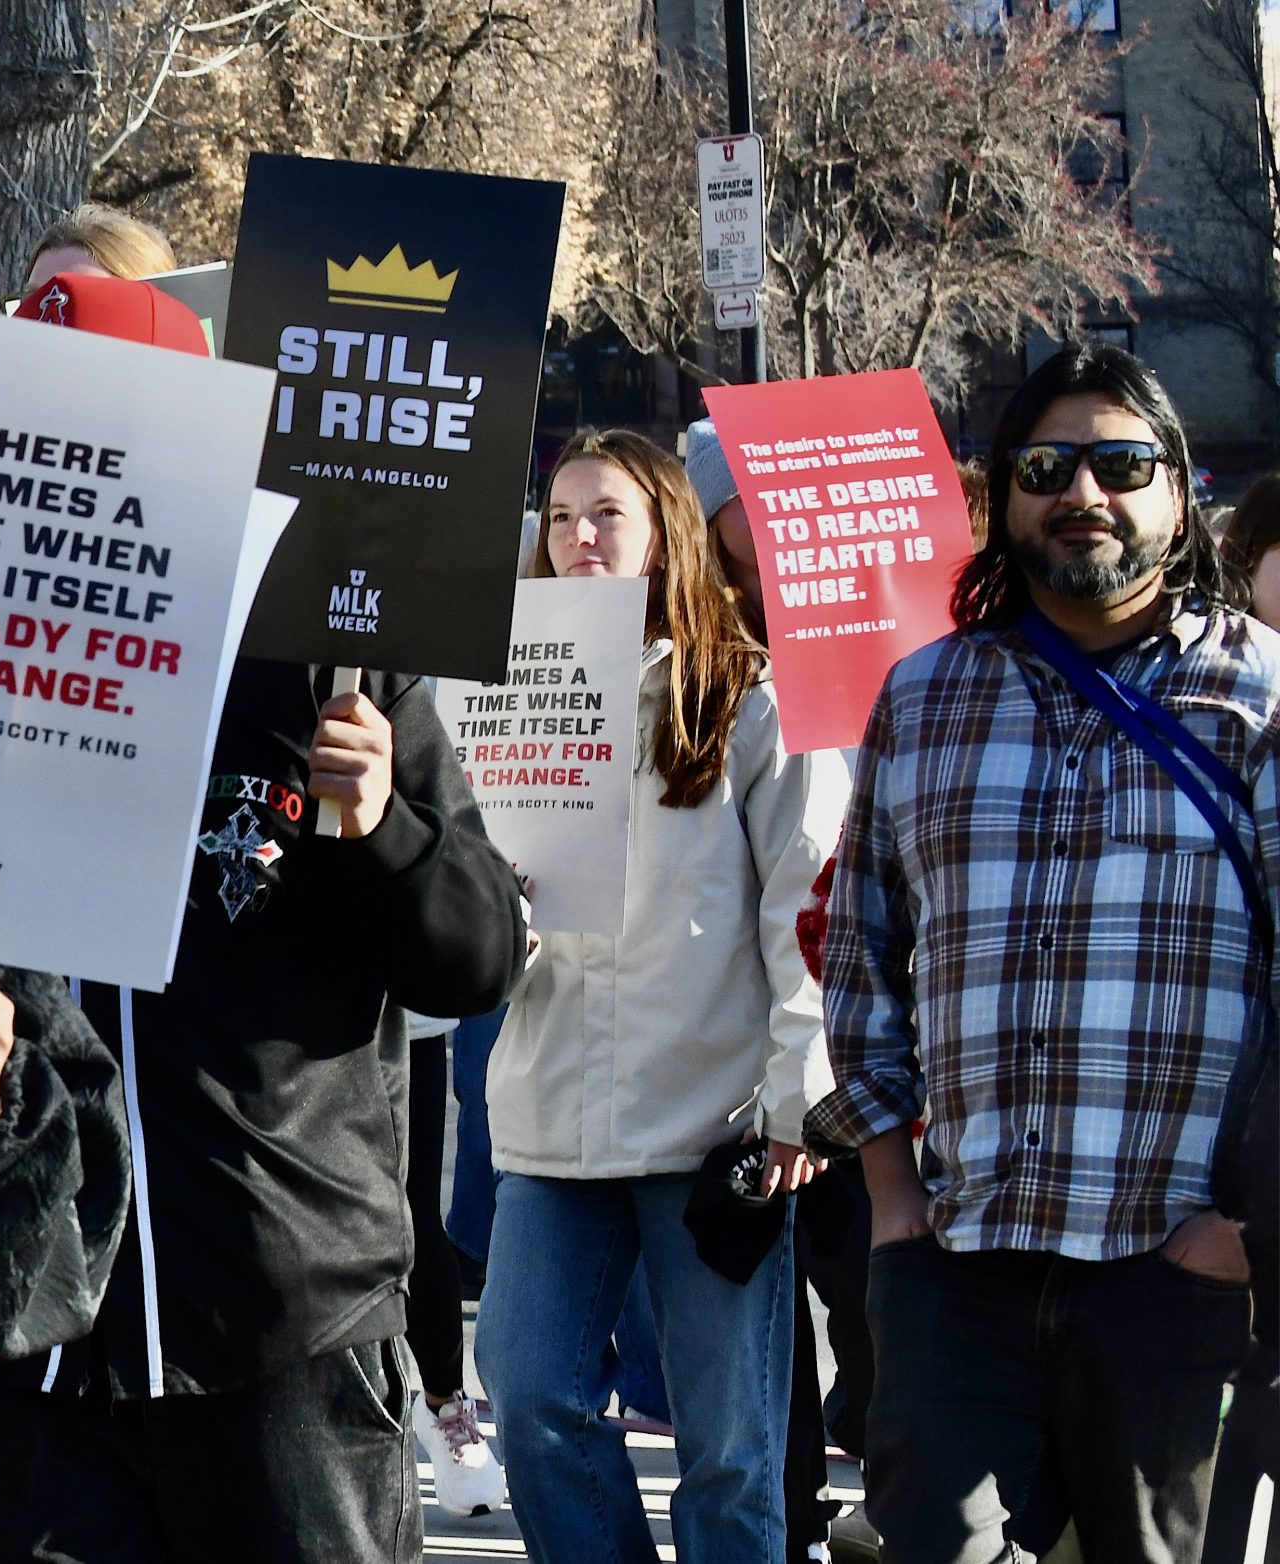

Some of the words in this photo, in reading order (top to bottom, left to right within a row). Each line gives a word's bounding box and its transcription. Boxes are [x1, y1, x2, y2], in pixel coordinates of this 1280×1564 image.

[708, 181, 721, 191] PAY
[723, 179, 740, 189] FAST
[742, 178, 752, 187] ON
[708, 191, 727, 201] YOUR
[729, 188, 753, 198] PHONE
[277, 325, 483, 401] STILL,
[276, 385, 295, 434] I
[319, 389, 475, 451] RISE
[740, 442, 771, 458] The
[774, 437, 826, 456] desire
[827, 435, 846, 449] to
[848, 428, 894, 446] reach
[895, 426, 919, 442] for
[747, 459, 776, 475] the
[778, 454, 822, 472] stars
[822, 452, 839, 467] is
[841, 445, 925, 465] ambitious.
[361, 467, 449, 490] ANGELOU
[758, 486, 822, 513] THE
[826, 473, 938, 507] DESIRE
[113, 496, 144, 528] A
[767, 517, 810, 544] TO
[816, 505, 919, 539] REACH
[23, 522, 172, 577] WHEN
[775, 540, 896, 576] HEARTS
[904, 536, 933, 563] IS
[3, 566, 174, 623] ITSELF
[328, 585, 382, 617] MLK
[779, 576, 866, 608] WISE.
[328, 614, 378, 634] WEEK
[836, 619, 896, 636] ANGELOU
[85, 628, 183, 676] FOR
[509, 642, 575, 661] HERE
[571, 667, 587, 685] A
[464, 694, 519, 713] TIME
[527, 692, 602, 710] WHEN
[457, 718, 512, 738] TIME
[520, 718, 605, 735] ITSELF
[80, 735, 138, 759] KING
[474, 743, 554, 762] READY
[562, 743, 613, 762] FOR
[482, 768, 590, 787] CHANGE.
[517, 800, 557, 809] SCOTT
[562, 801, 594, 811] KING
